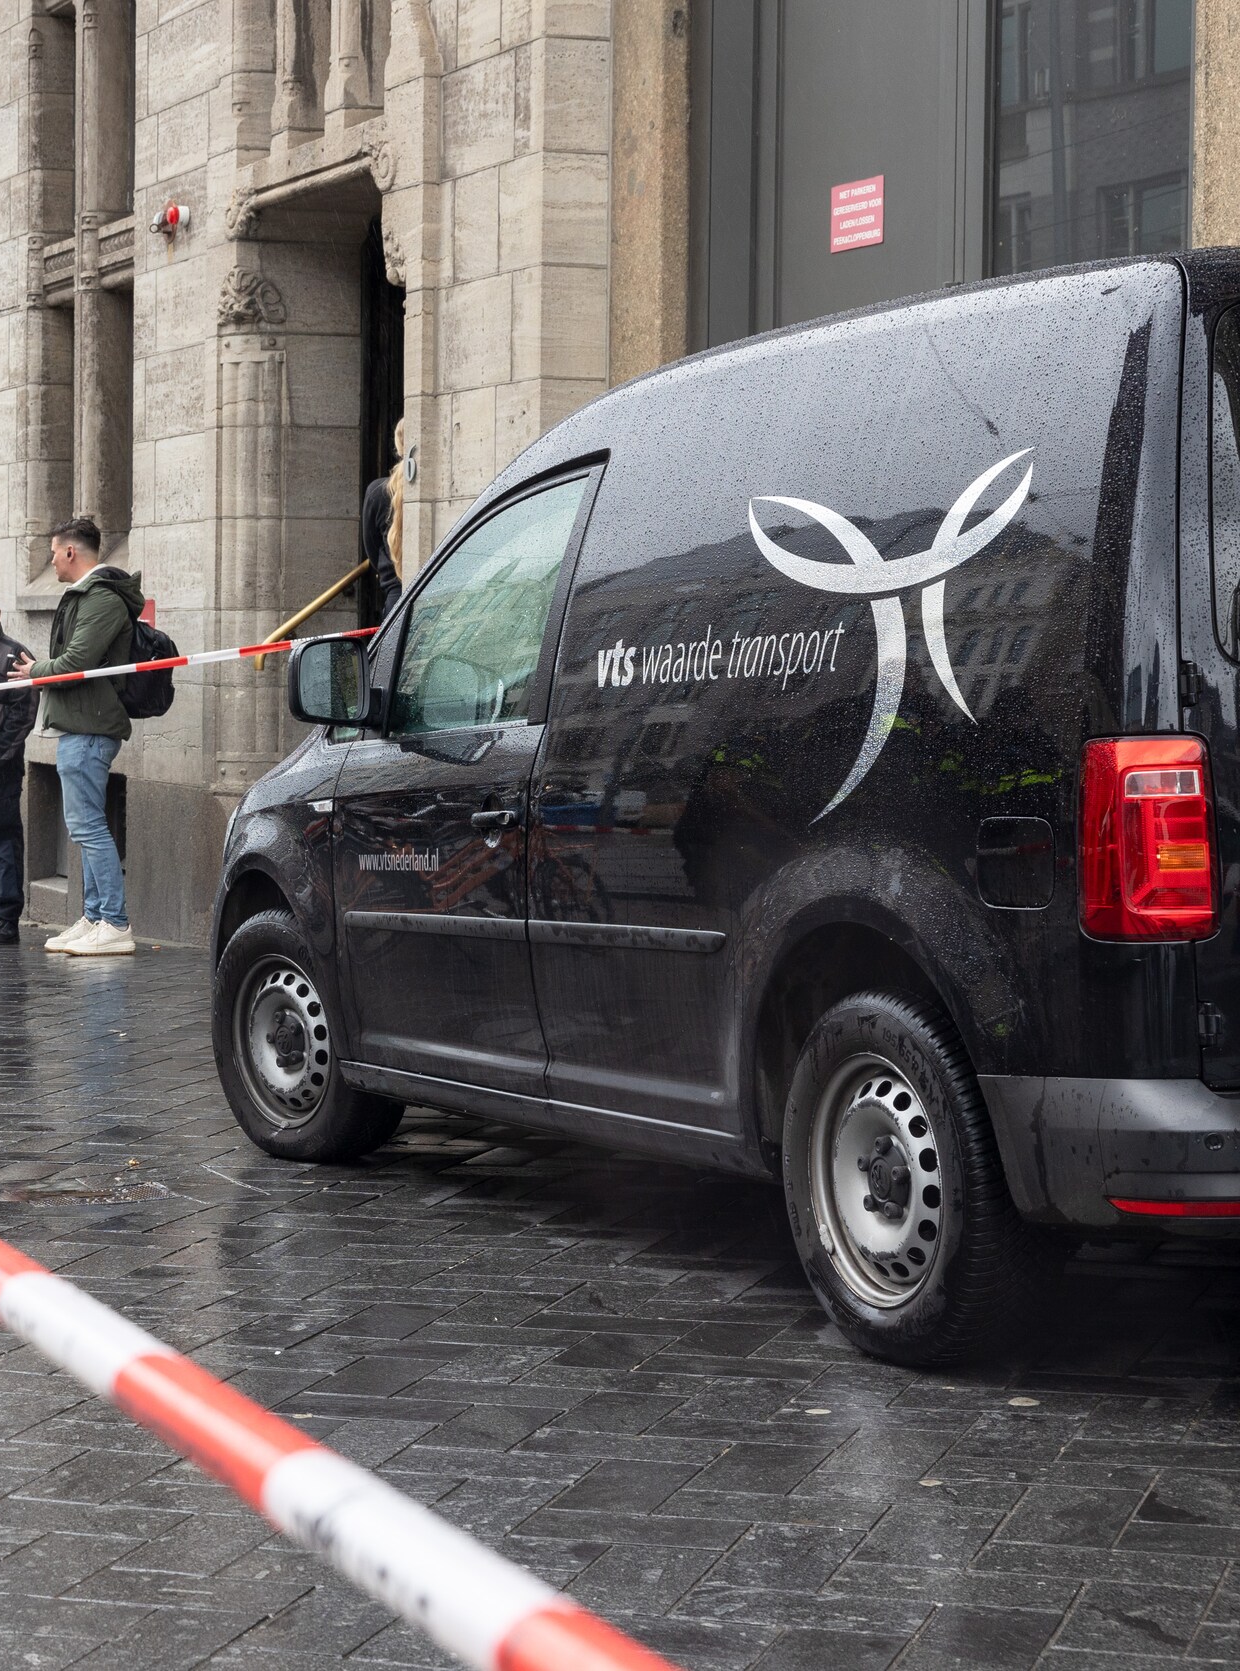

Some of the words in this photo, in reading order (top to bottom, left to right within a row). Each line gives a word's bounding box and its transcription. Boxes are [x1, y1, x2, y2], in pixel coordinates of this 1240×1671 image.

[597, 638, 637, 688] vts
[642, 625, 722, 684] waarde
[726, 621, 845, 690] transport
[358, 847, 439, 872] www.vtsnederland.nl
